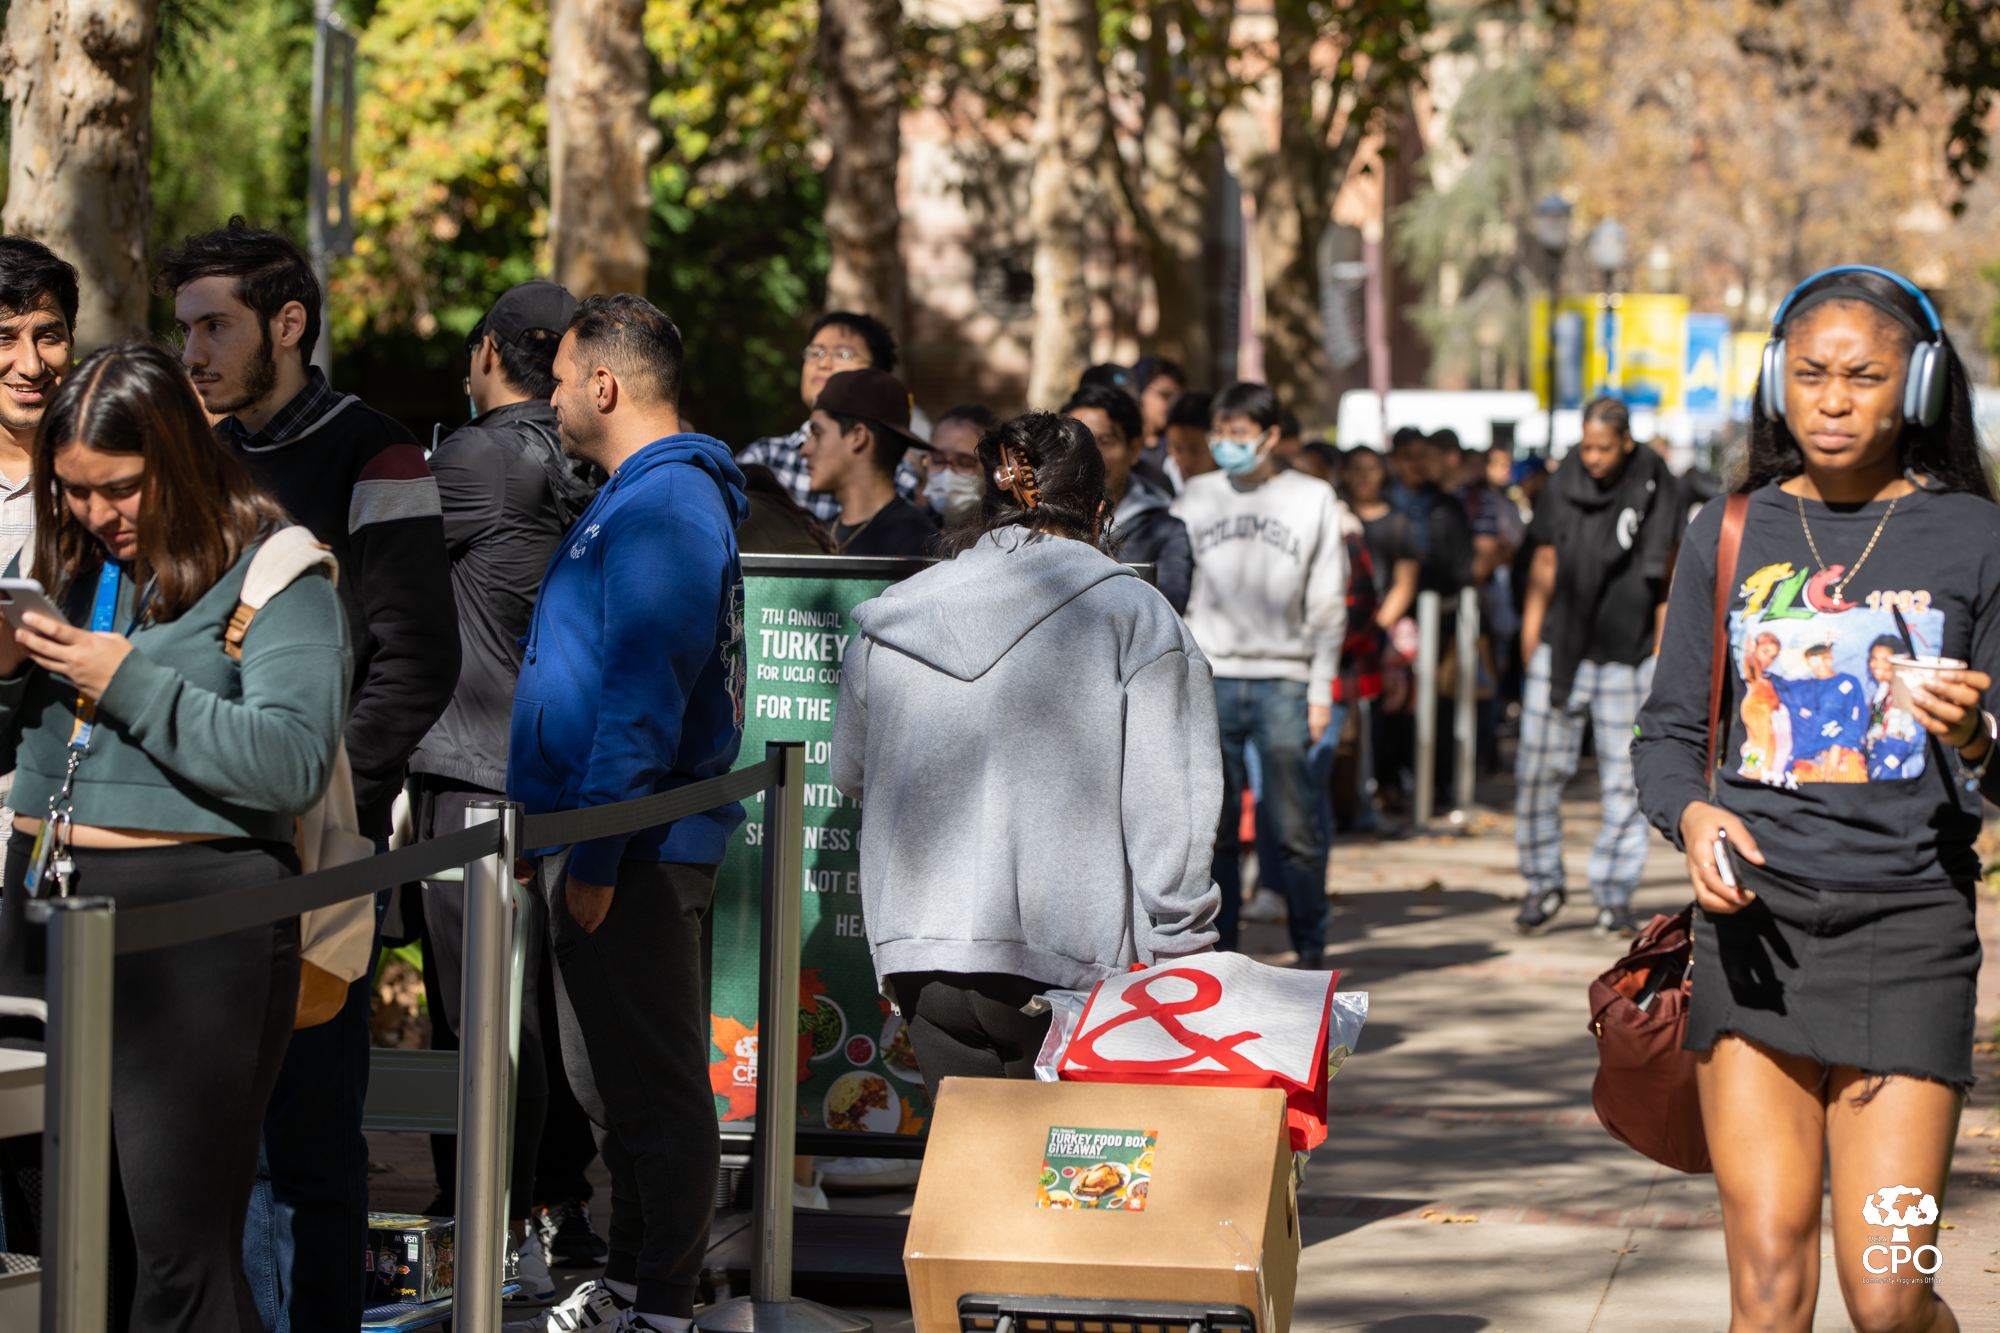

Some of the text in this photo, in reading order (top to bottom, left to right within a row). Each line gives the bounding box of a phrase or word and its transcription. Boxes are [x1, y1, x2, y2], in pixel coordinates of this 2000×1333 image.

[1739, 562, 1931, 621] TLC 1992
[761, 607, 842, 628] 7TH ANNUAL
[759, 629, 850, 662] TURKEY
[757, 664, 779, 680] FOR
[783, 665, 815, 683] UCLA
[756, 695, 832, 721] FOR THE
[804, 868, 842, 893] NOT
[732, 1065, 758, 1082] CP
[1048, 1143, 1104, 1156] GIVEAWAY
[1050, 1132, 1148, 1148] TURKEY FOOD BOX
